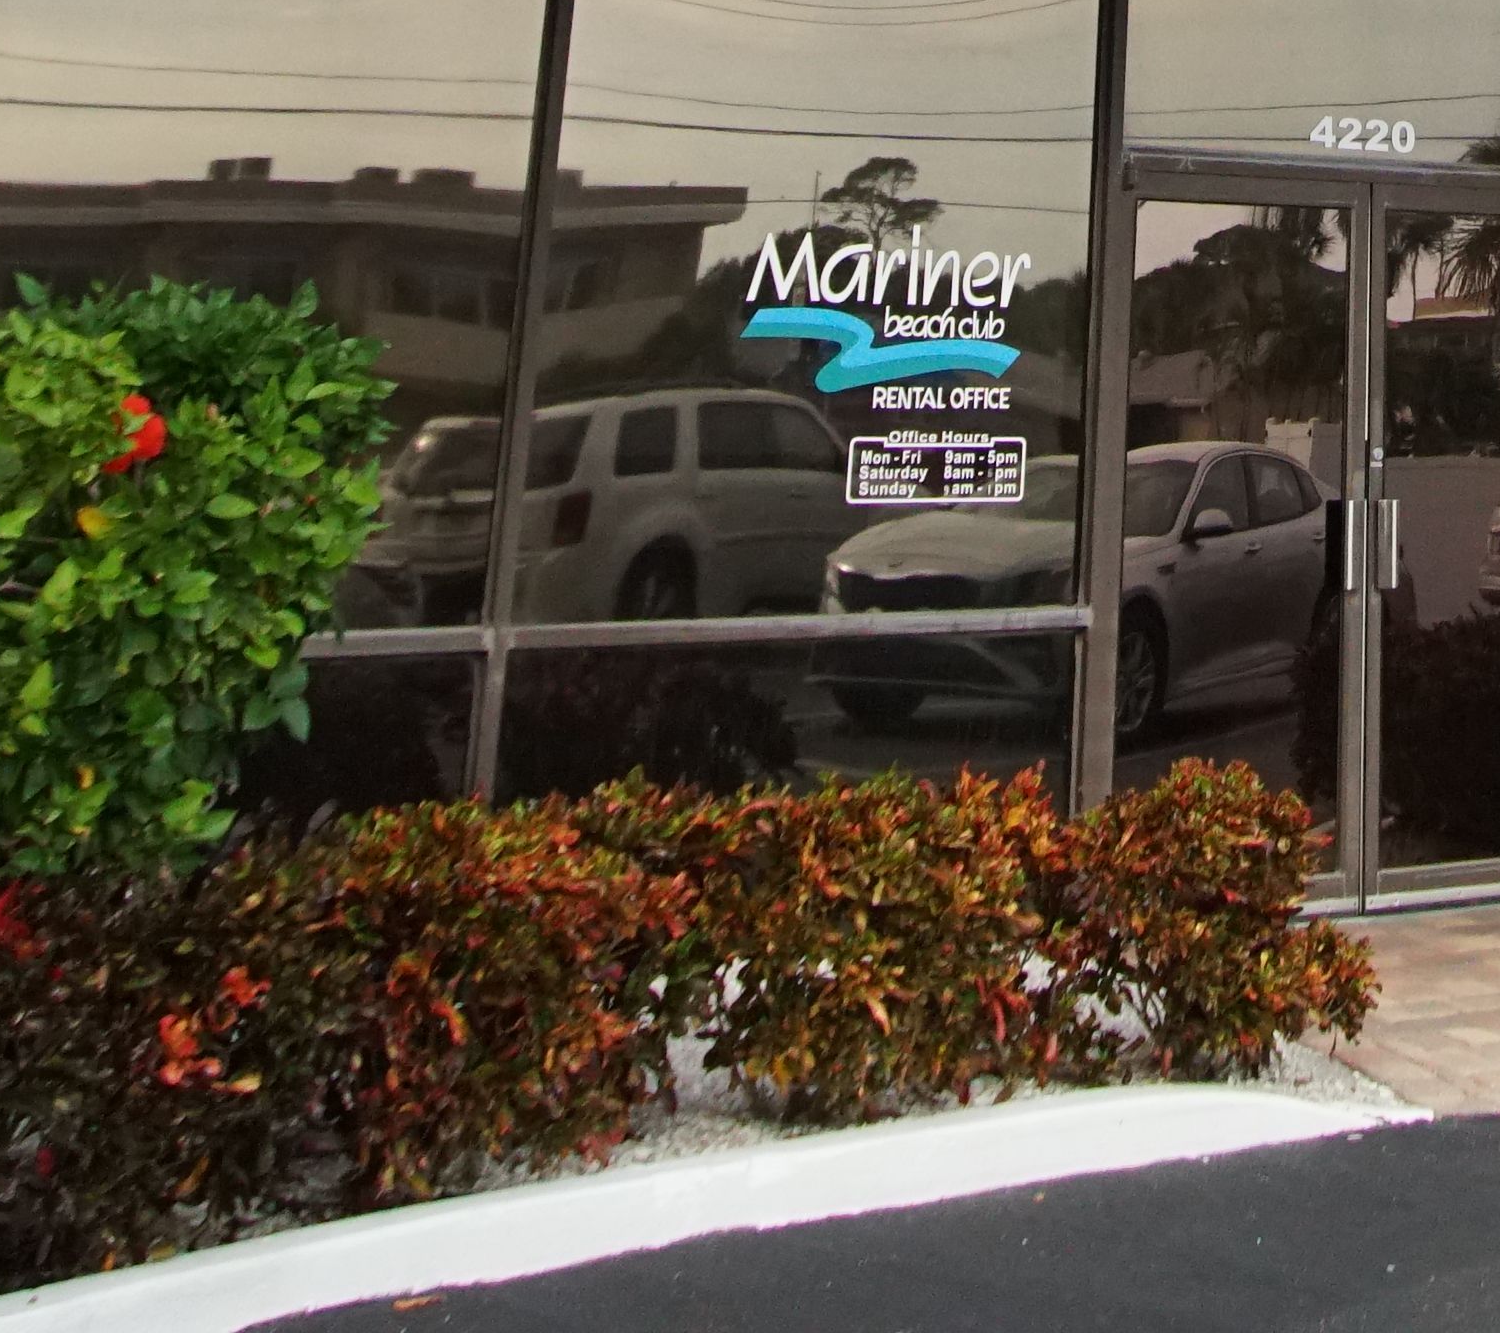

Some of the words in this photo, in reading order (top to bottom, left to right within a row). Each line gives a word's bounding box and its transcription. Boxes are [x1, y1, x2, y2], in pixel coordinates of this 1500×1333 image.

[1309, 115, 1415, 153] 4220
[746, 224, 1031, 308] Mariner
[884, 305, 956, 338] beach
[958, 310, 1005, 339] club
[872, 386, 946, 410] RENTAL
[950, 387, 1011, 410] OFFICE
[888, 430, 937, 443] Office
[941, 430, 989, 443] Hours
[860, 450, 890, 465] Mon
[902, 450, 922, 465] Fri
[944, 450, 975, 465] 9am
[987, 449, 1018, 467] 5pm
[858, 465, 928, 483] Saturday
[943, 465, 974, 480] 8am
[858, 481, 916, 498] Sunday
